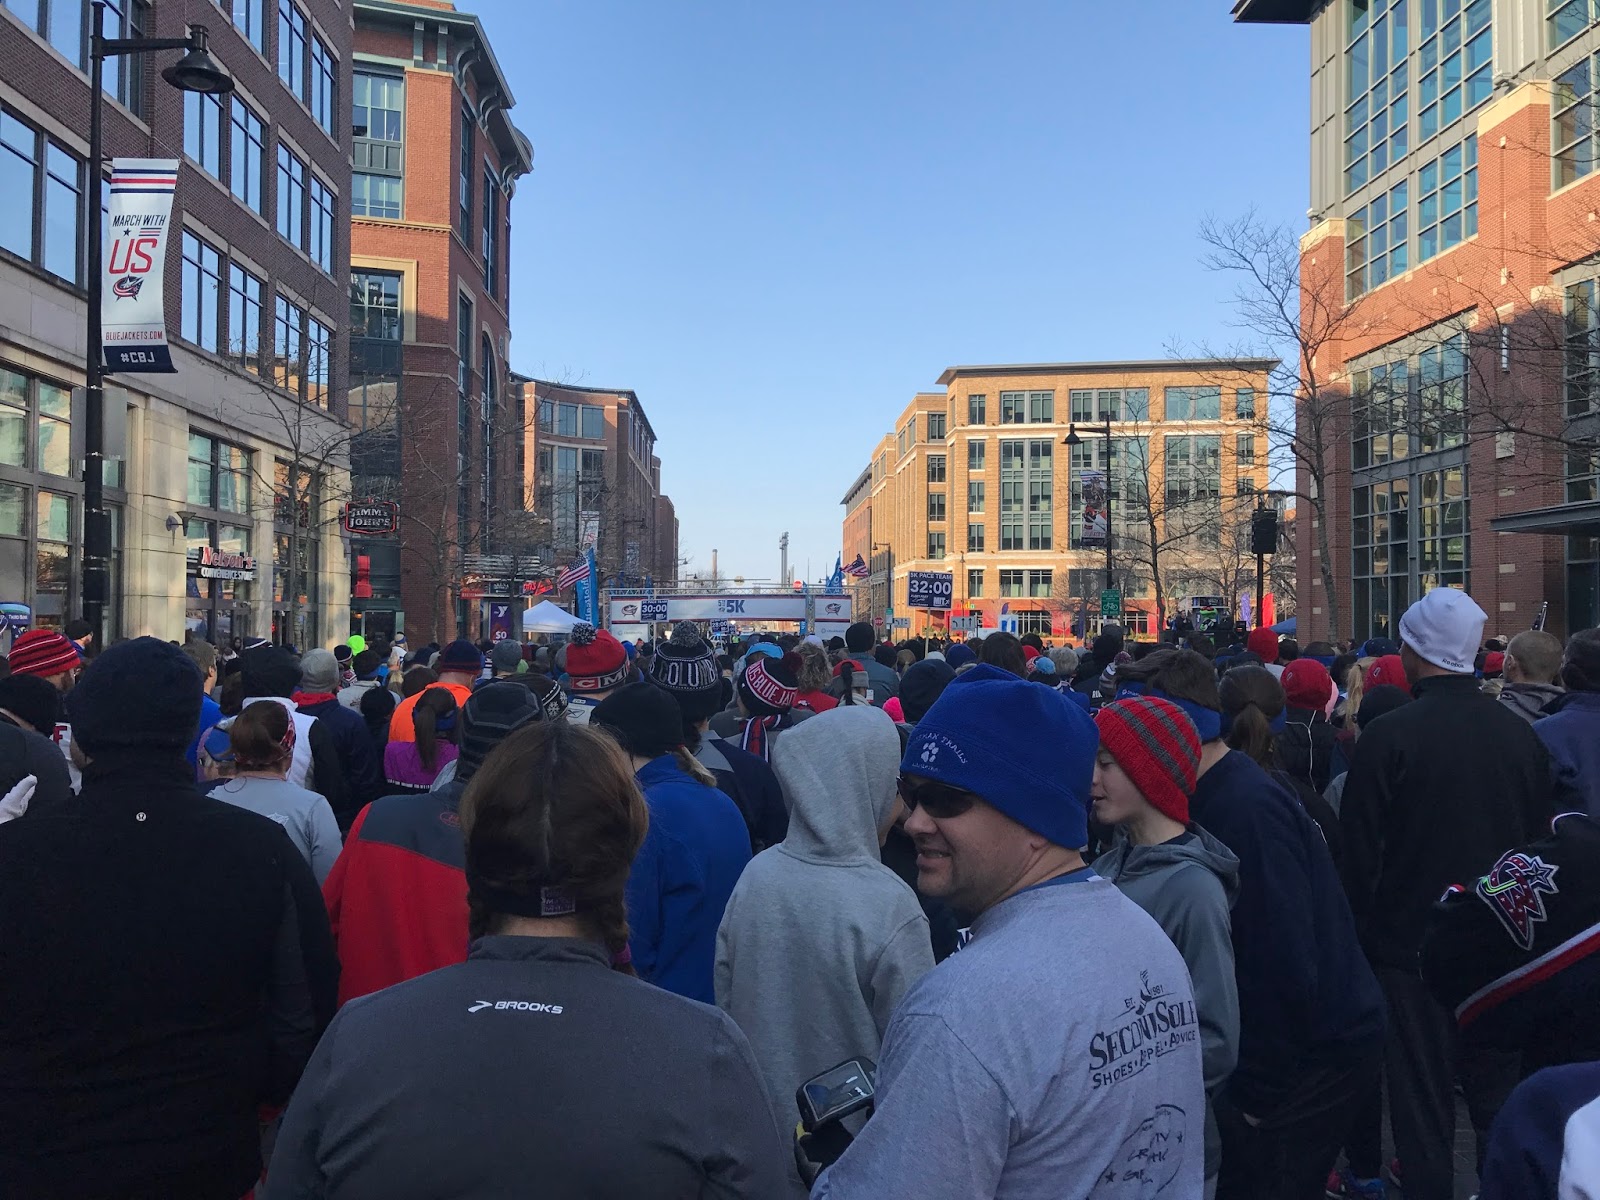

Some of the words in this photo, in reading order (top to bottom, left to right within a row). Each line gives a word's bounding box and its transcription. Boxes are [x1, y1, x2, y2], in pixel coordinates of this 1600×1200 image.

[112, 215, 142, 227] MARCH
[143, 215, 166, 226] WITH
[109, 238, 158, 274] US
[105, 331, 163, 341] BLUEJACKETS.COM
[120, 352, 155, 363] #CBJ
[201, 546, 253, 569] Nelson's
[910, 580, 951, 595] 32:00
[641, 604, 667, 613] 30:00
[726, 599, 745, 613] 5K
[495, 631, 507, 640] $0
[753, 674, 780, 701] BLUE
[494, 1001, 563, 1014] BROOKS
